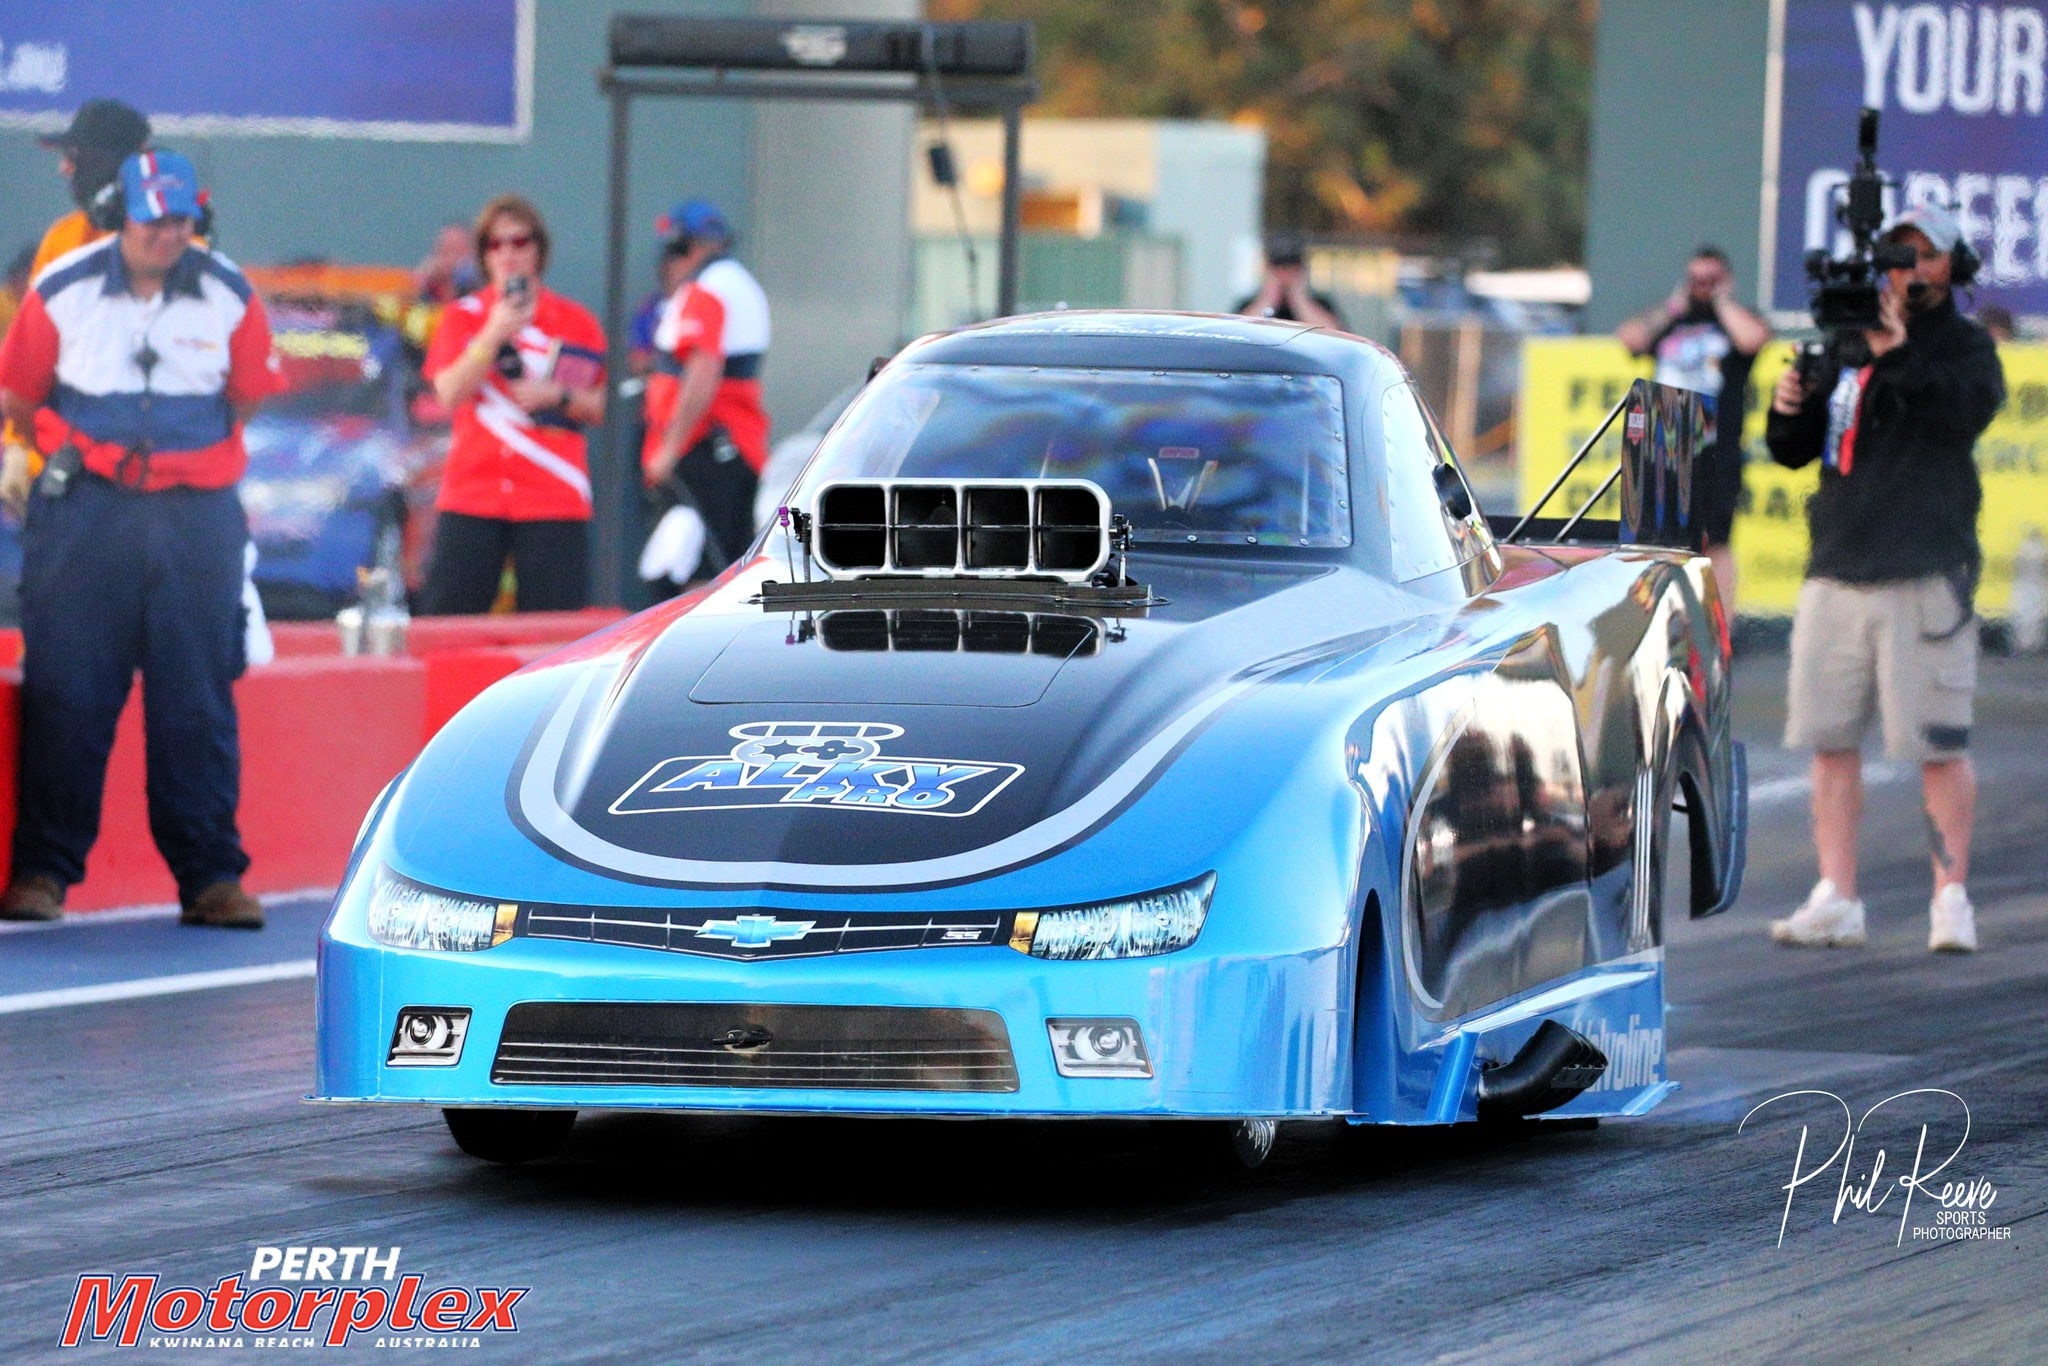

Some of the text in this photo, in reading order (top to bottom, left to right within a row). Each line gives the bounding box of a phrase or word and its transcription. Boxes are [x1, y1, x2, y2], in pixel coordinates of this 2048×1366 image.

[1852, 3, 2046, 116] YOUR
[649, 761, 998, 792] ALKY
[779, 783, 955, 808] PRO
